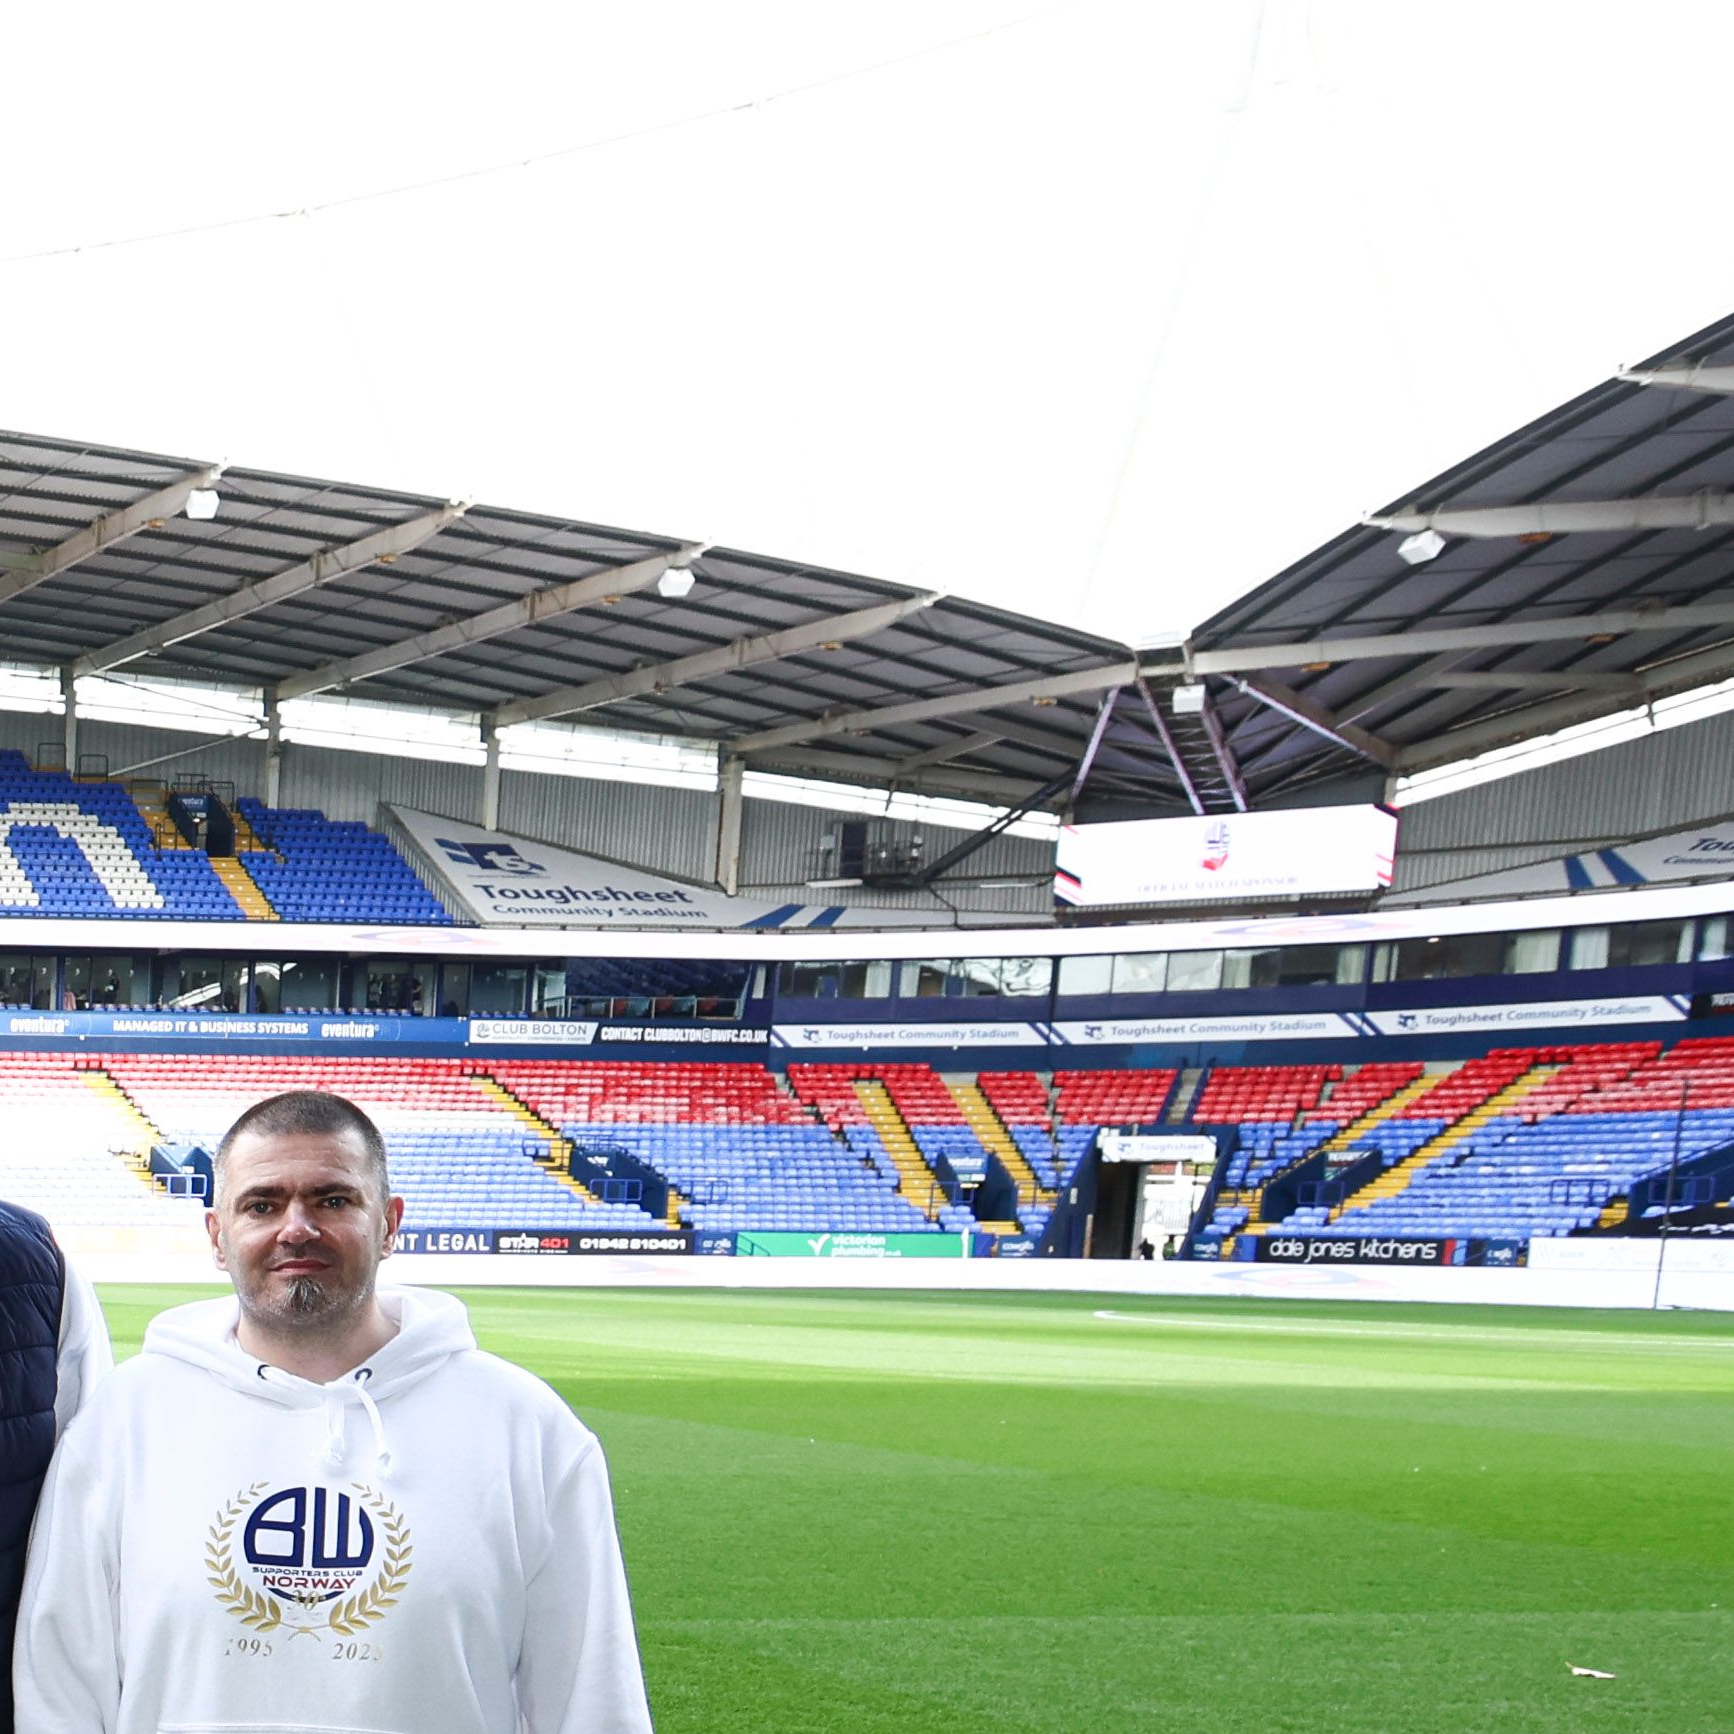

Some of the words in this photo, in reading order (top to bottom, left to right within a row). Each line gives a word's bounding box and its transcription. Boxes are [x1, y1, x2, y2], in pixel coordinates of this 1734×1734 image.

[473, 883, 694, 904] Toughsheet
[492, 904, 613, 919] Community
[618, 905, 709, 919] Stadium
[1425, 1011, 1502, 1026] Toughsheet
[1506, 1007, 1587, 1022] Community
[1590, 1003, 1652, 1016] Stadium
[10, 1016, 65, 1032] eventura
[113, 1020, 173, 1032] MANAGED
[175, 1021, 187, 1032] IT
[188, 1021, 199, 1033] &
[200, 1021, 257, 1034] BUSINESS
[258, 1022, 309, 1034] SYSTEMS
[321, 1020, 374, 1038] eventura
[492, 1023, 528, 1034] CLUB
[532, 1023, 588, 1035] BOLTON
[1111, 1024, 1186, 1037] Toughsheet
[1189, 1022, 1266, 1035] Community
[1270, 1019, 1326, 1031] Stadium
[600, 1026, 644, 1041] CONTACT
[644, 1027, 768, 1044] CLUBBOLTON@BWFC.CO.UK
[827, 1029, 895, 1042] Toughsheet
[899, 1029, 966, 1041] Community
[969, 1028, 1019, 1038] Stadium
[426, 1234, 490, 1251] LEGAL
[832, 1234, 886, 1246] victorian
[1270, 1238, 1305, 1256] dale
[1305, 1240, 1356, 1263] jones
[1359, 1239, 1437, 1260] kitchens
[243, 1486, 375, 1569] BW
[252, 1566, 330, 1577] SUPPORTERS
[262, 1575, 357, 1590] NORWAY
[224, 1638, 273, 1657] 1995
